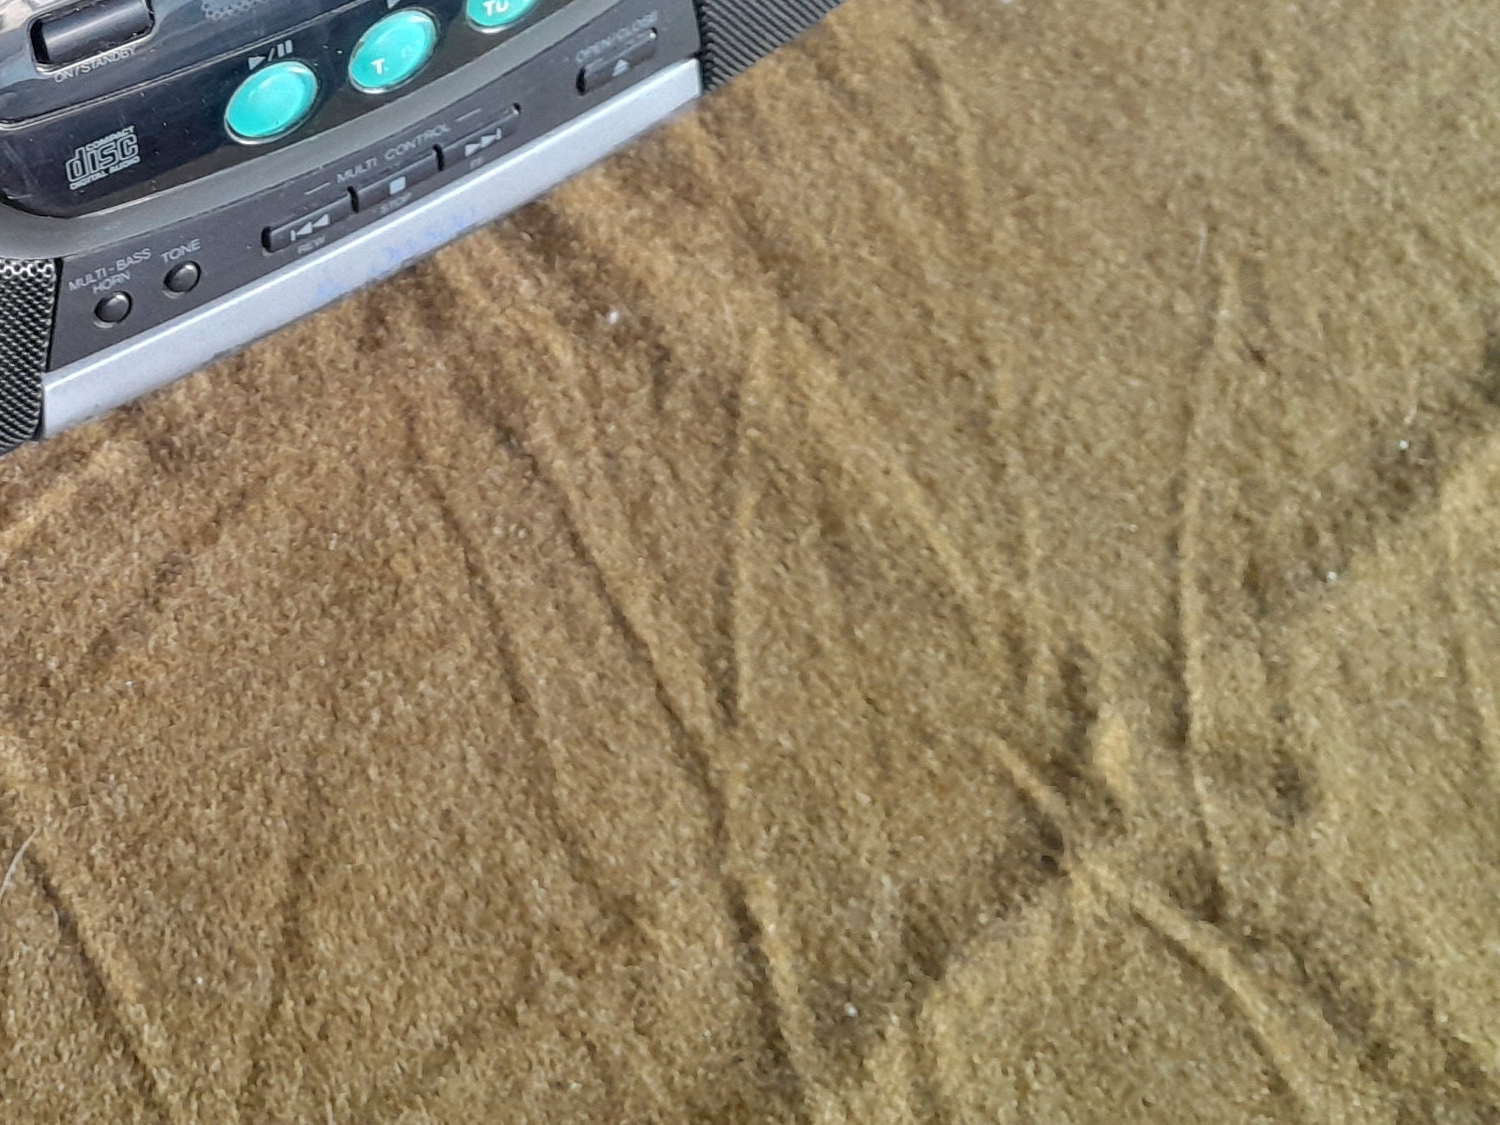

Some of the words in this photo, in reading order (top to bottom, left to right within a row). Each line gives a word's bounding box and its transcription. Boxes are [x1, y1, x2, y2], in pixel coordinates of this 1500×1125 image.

[53, 47, 135, 83] ON/STANDBY
[65, 133, 139, 182] disc
[336, 157, 378, 185] MULTI
[383, 123, 451, 161] CONTROL
[160, 238, 201, 263] TONE
[92, 270, 131, 294] HORN
